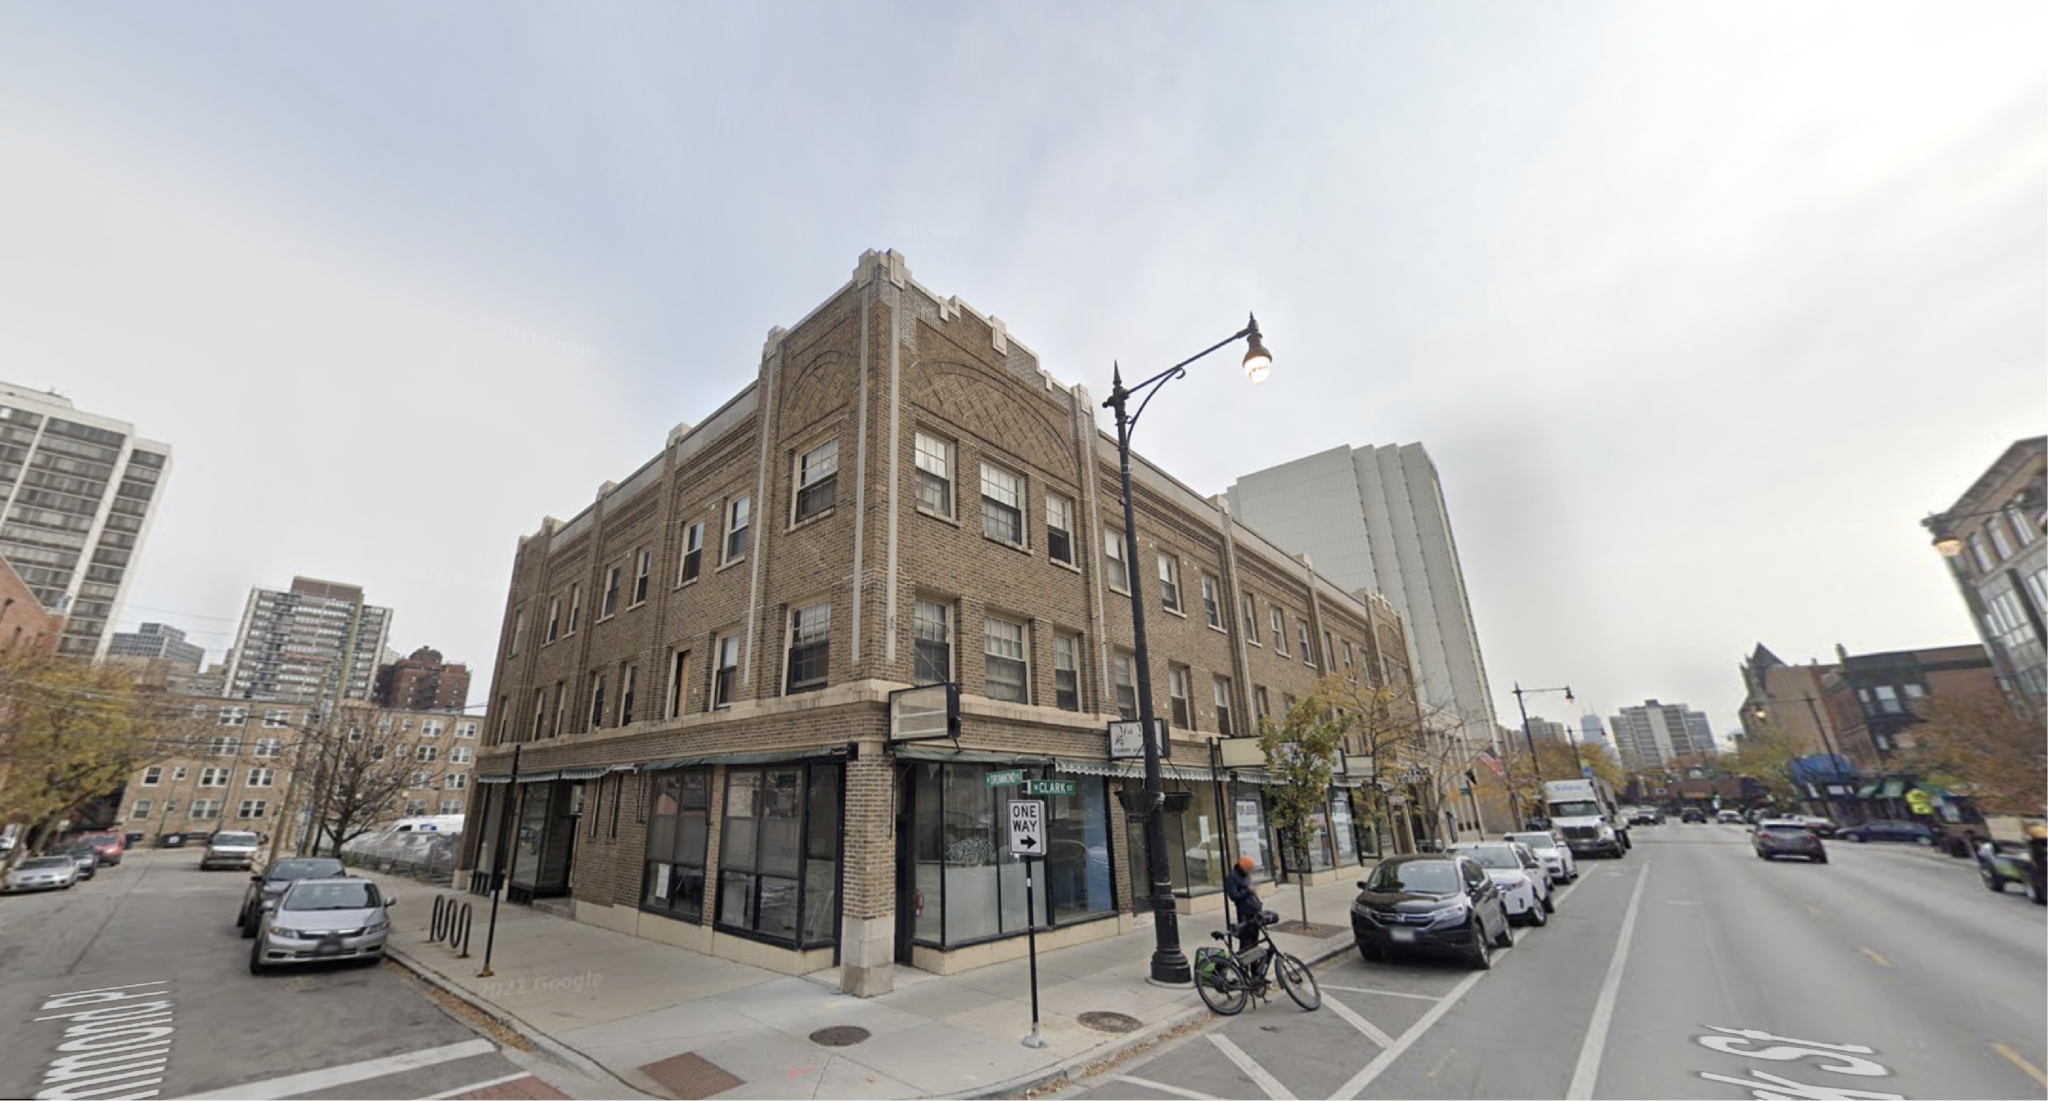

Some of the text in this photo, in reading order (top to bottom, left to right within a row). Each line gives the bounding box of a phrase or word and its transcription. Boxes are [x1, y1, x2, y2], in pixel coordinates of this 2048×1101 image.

[1039, 782, 1066, 793] CLARK
[1012, 805, 1037, 818] ONE
[1012, 820, 1037, 832] WAY
